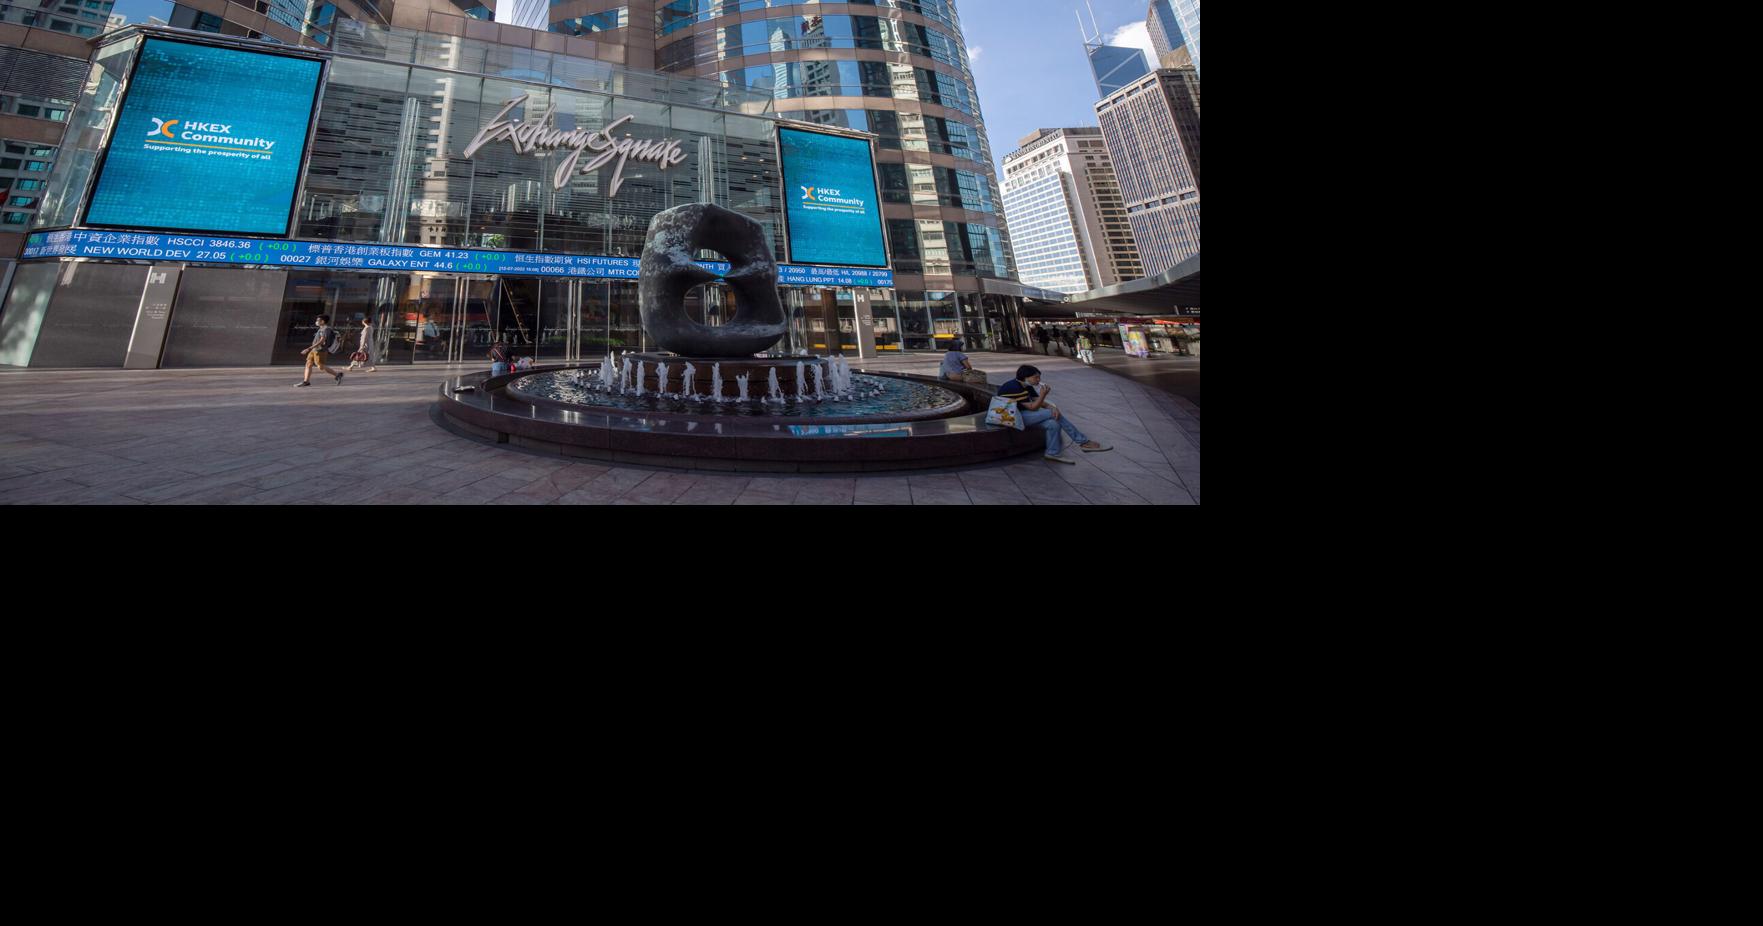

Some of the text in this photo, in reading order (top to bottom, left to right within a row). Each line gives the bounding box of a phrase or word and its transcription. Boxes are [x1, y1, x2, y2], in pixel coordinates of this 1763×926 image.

[184, 121, 232, 134] HKEX
[181, 131, 275, 150] Community
[464, 94, 688, 197] Exchange Square
[144, 143, 191, 154] Supporting
[208, 150, 249, 160] prosperity
[817, 187, 841, 196] HKEX
[818, 195, 864, 207] Community
[83, 246, 115, 255] NEW
[117, 247, 163, 257] WORLD
[165, 249, 191, 258] DEV
[196, 250, 227, 260] 27.05
[280, 254, 311, 263] 00027
[368, 258, 408, 268] GALAXY
[434, 261, 453, 269] 44.6
[541, 265, 565, 274] 00066
[167, 237, 205, 247] HSCCI
[209, 238, 251, 250] 3846.36
[419, 250, 442, 258] GEM
[445, 251, 469, 260] 41.23
[577, 257, 591, 265] HSI
[592, 258, 629, 267] FUTURES
